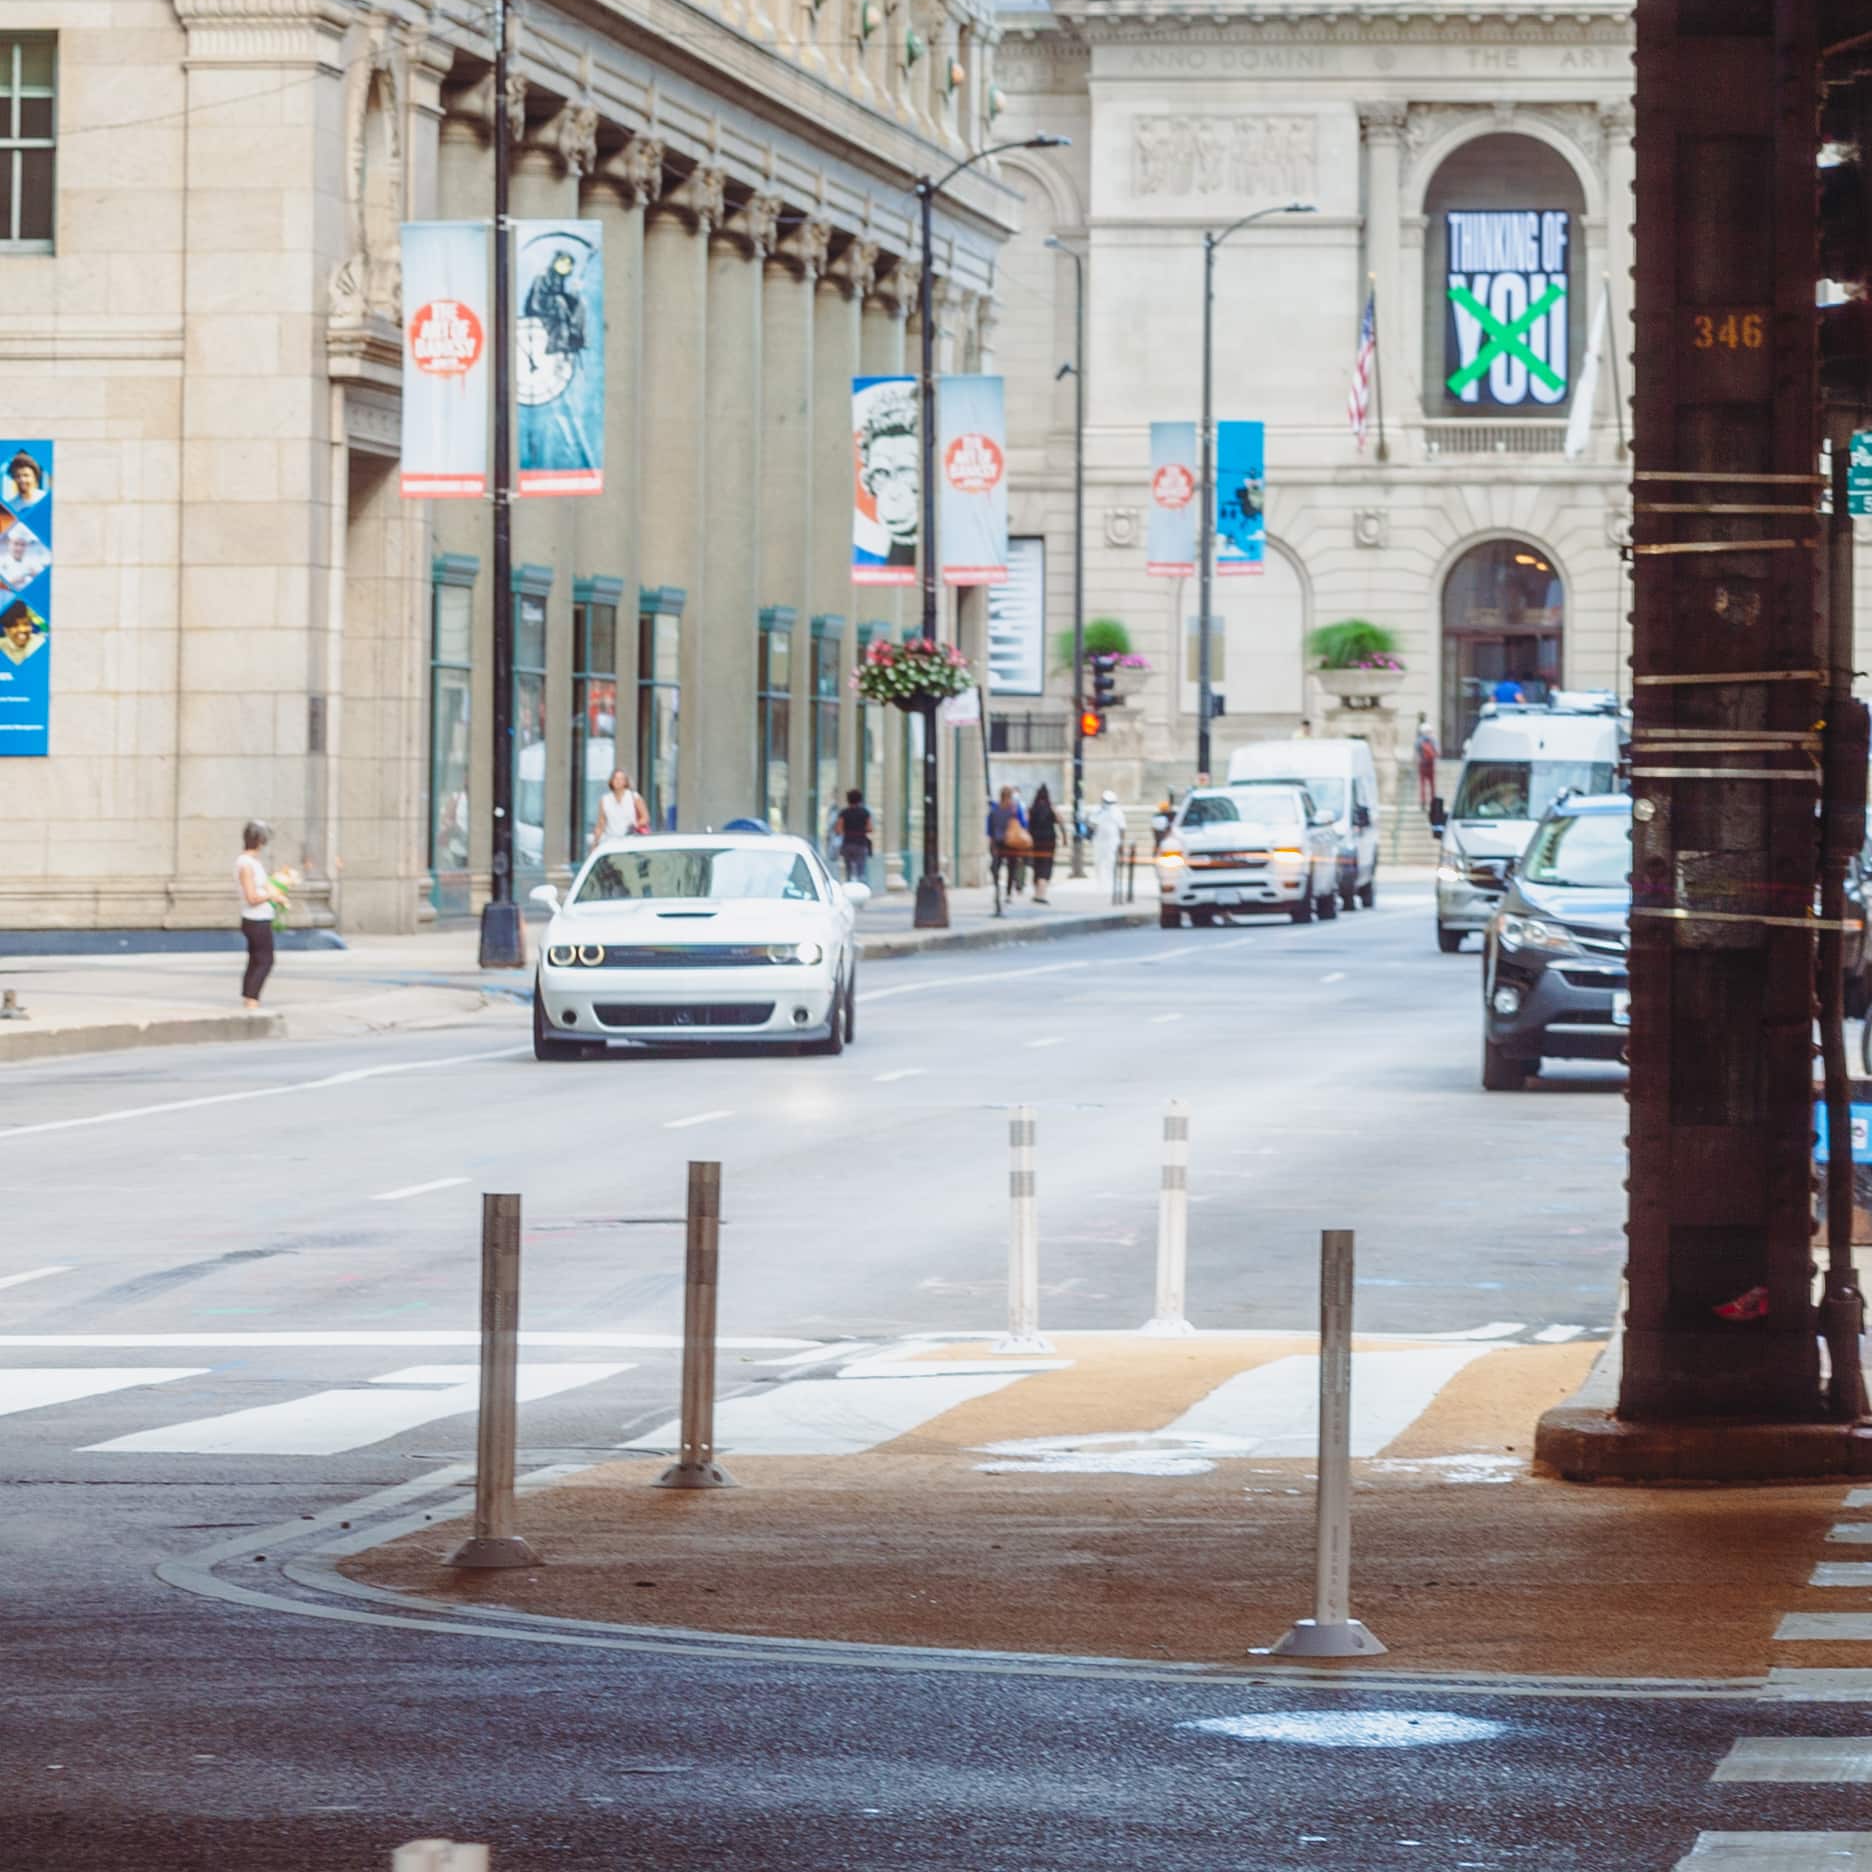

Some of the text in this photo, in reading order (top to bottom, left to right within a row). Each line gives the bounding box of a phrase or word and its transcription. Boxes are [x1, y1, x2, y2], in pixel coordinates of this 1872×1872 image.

[1128, 47, 1617, 71] ANNO DOMINI THE ART
[1447, 211, 1569, 272] THINKING OF
[1447, 273, 1569, 405] YOU
[1694, 314, 1763, 349] 346
